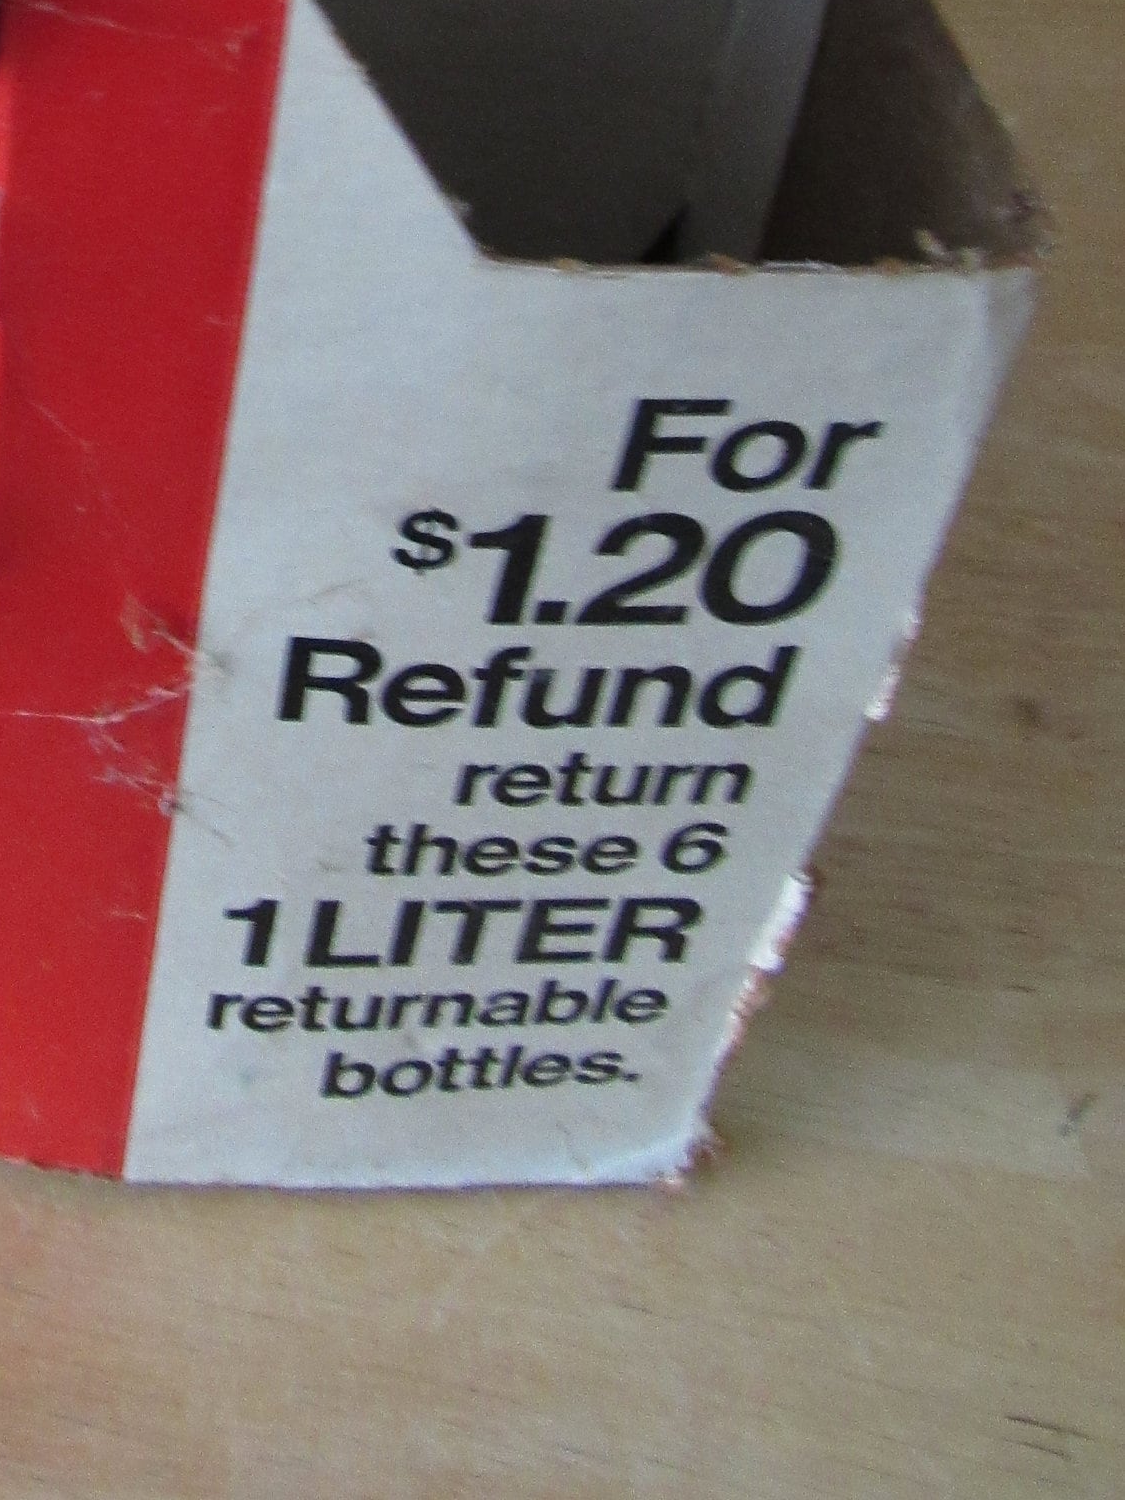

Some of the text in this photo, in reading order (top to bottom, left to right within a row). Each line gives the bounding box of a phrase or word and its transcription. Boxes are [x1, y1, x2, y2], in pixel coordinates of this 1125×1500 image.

[609, 397, 884, 494] For
[391, 507, 841, 627] $1.20
[277, 635, 802, 731] Refund
[454, 751, 754, 809] return
[365, 819, 732, 879] these 6
[303, 897, 705, 970] LITER
[207, 978, 670, 1034] returnable
[321, 1043, 642, 1101] bottles.
